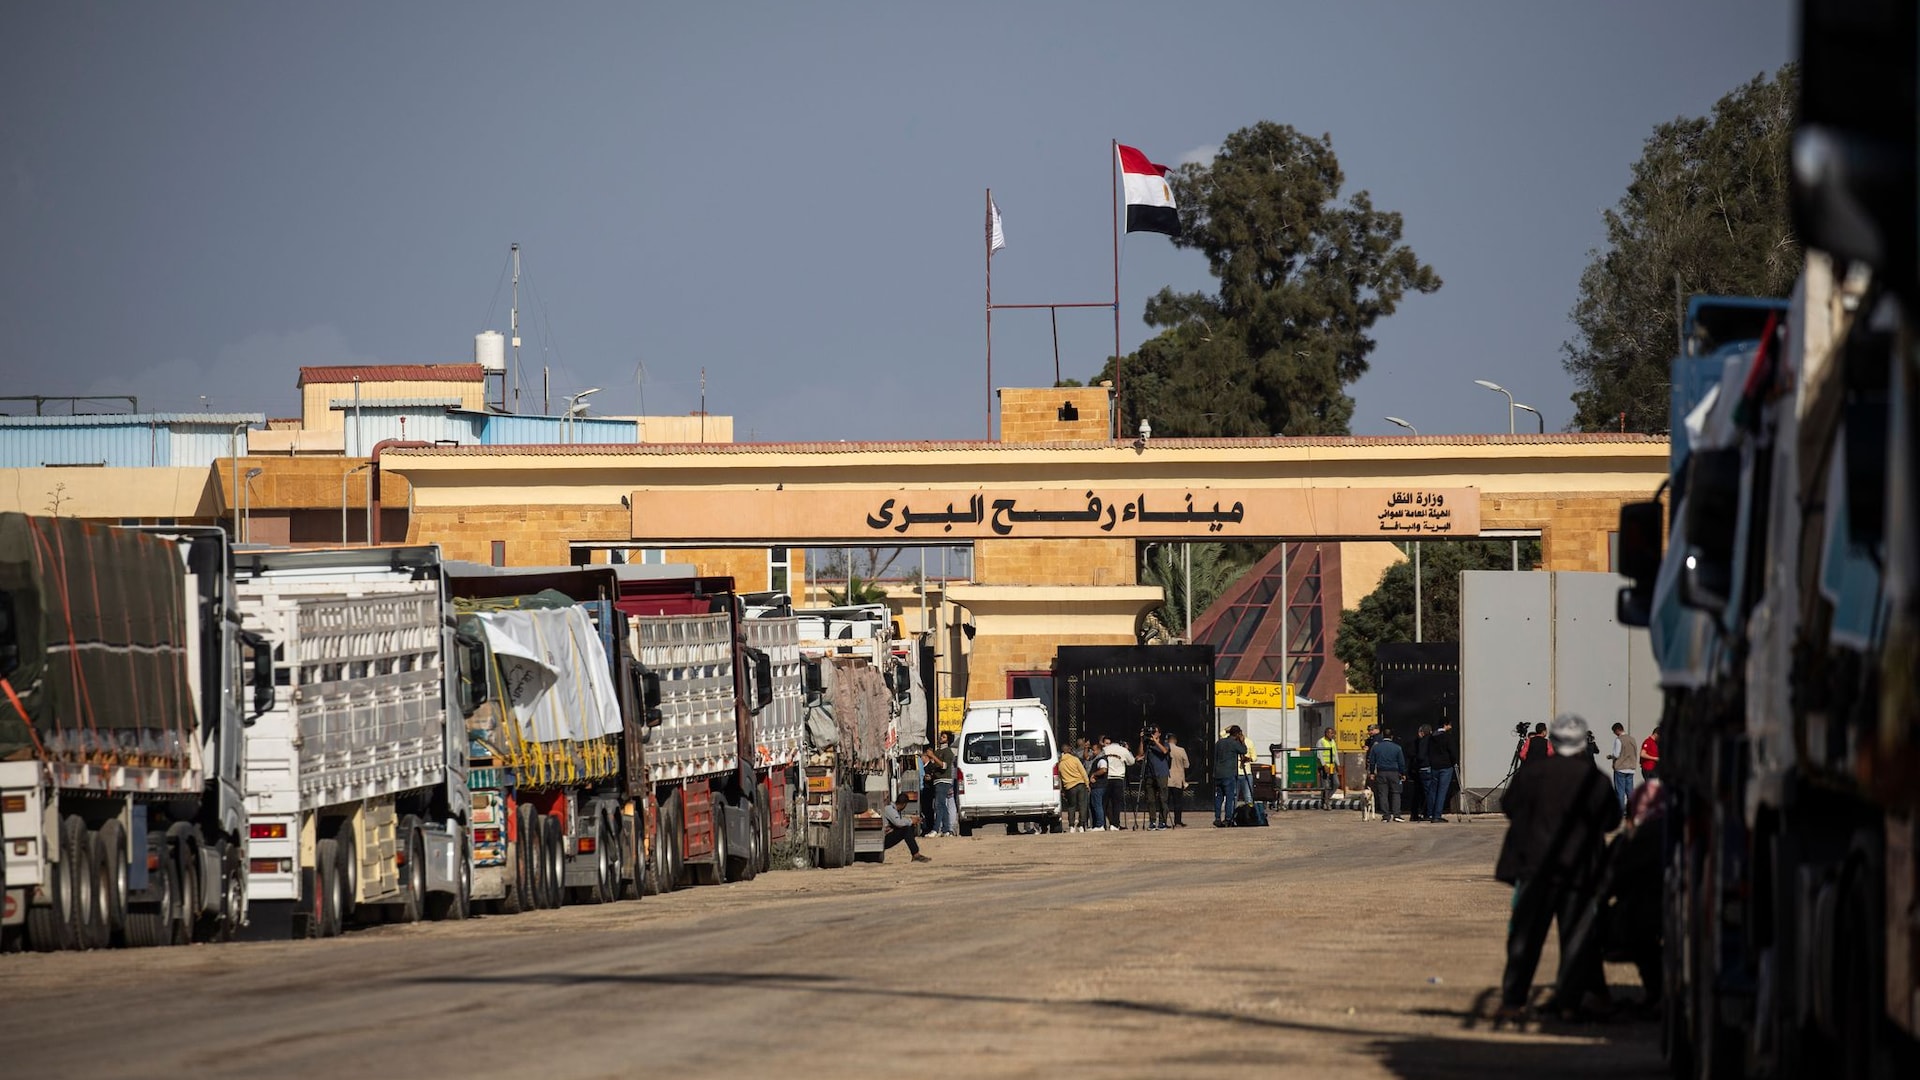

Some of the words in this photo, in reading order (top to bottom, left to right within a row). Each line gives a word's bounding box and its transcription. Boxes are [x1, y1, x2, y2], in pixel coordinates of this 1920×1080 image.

[991, 490, 1117, 535] رفح
[1121, 493, 1244, 532] ميناء
[1387, 492, 1413, 507] النقل
[1416, 492, 1444, 507] وزارة
